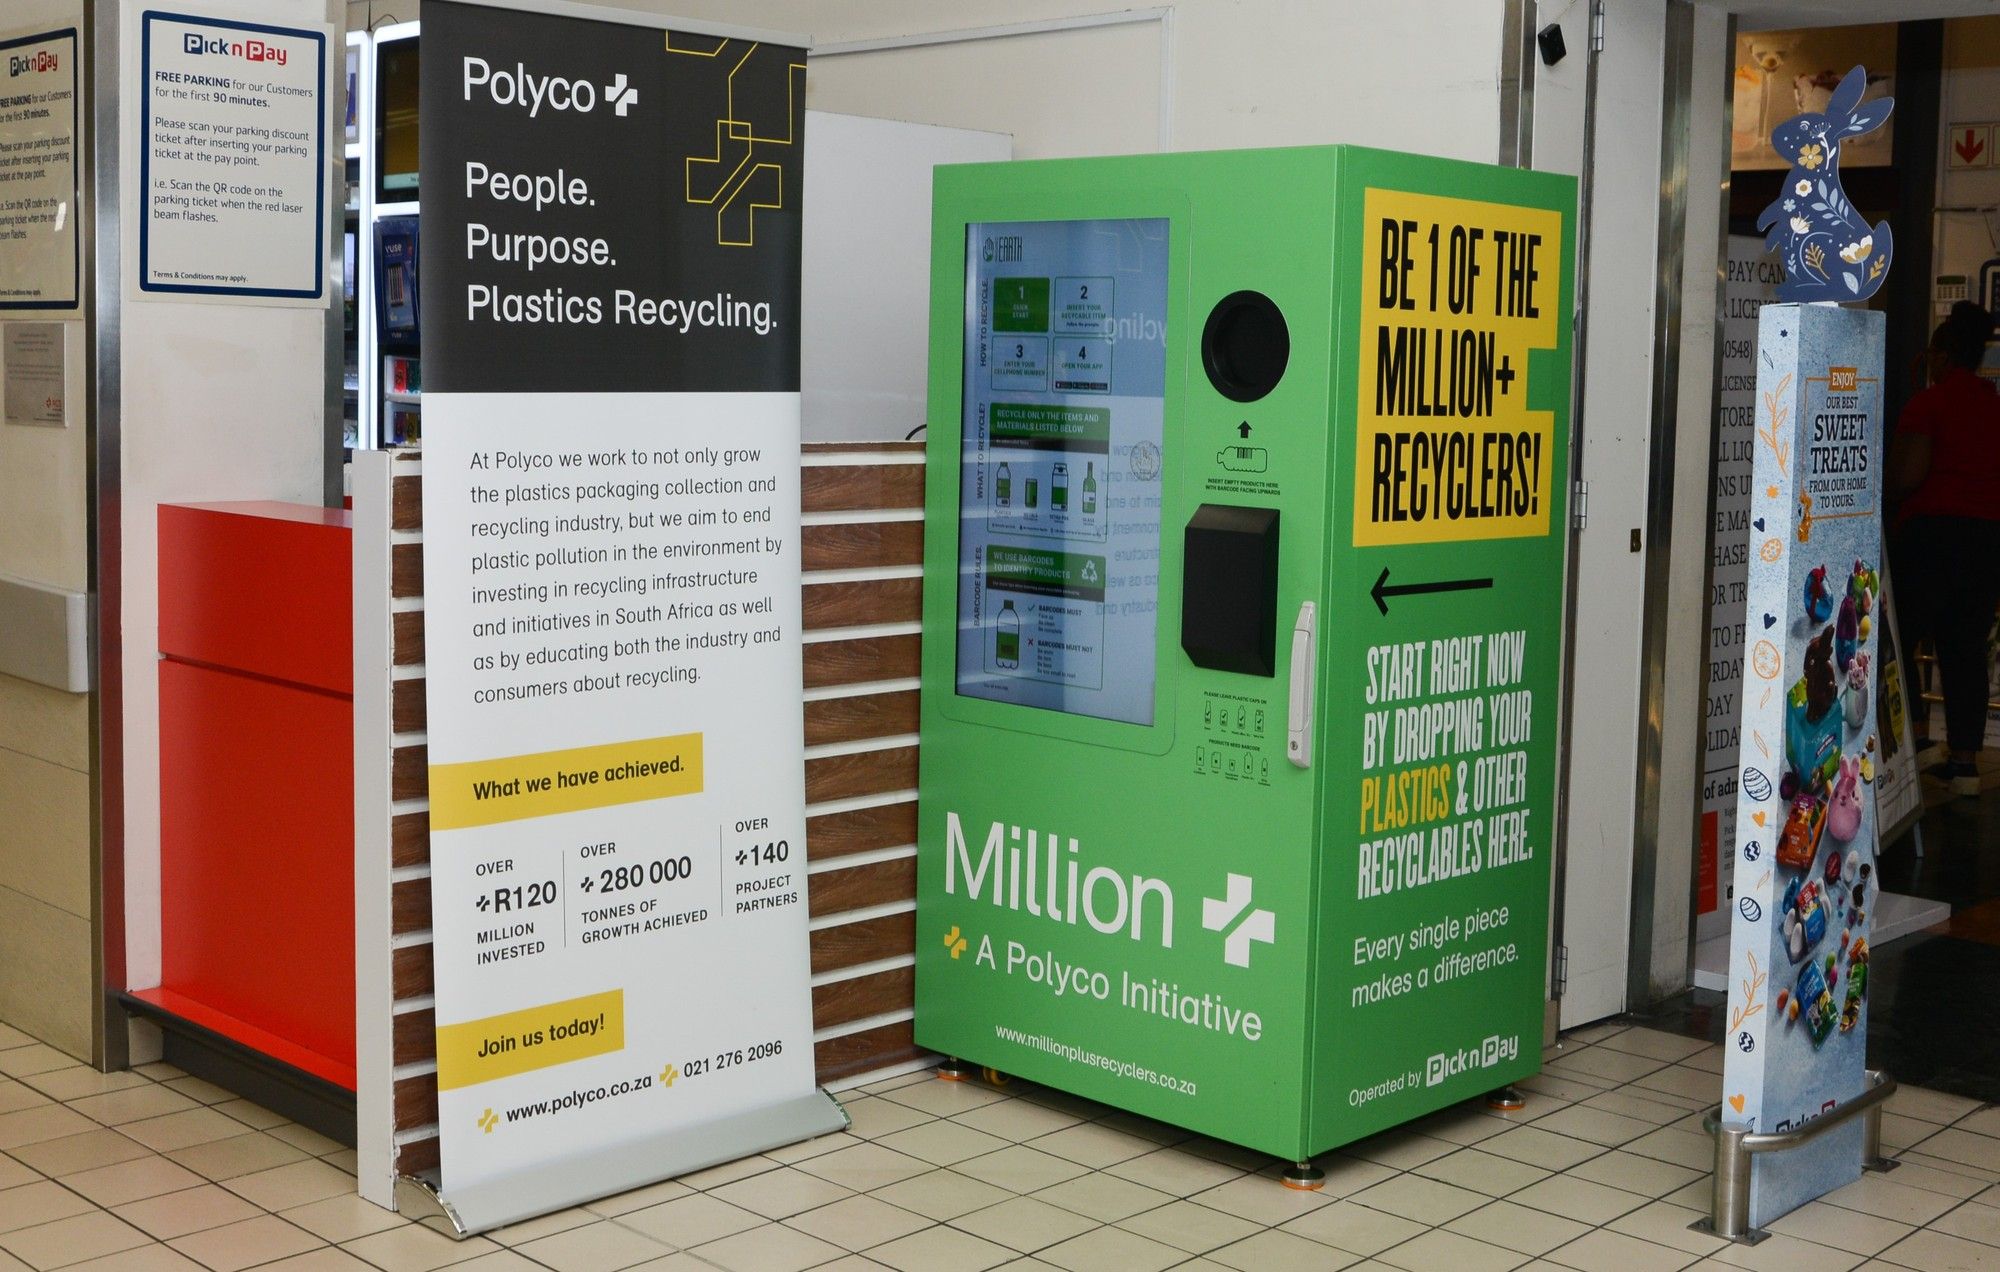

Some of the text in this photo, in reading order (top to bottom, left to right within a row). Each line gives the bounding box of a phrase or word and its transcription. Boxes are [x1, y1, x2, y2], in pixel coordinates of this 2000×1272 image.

[184, 33, 287, 65] Pick n Pay
[155, 71, 313, 98] FREE PARKING for our Customers
[464, 56, 595, 117] Polyco
[154, 180, 283, 197] i.e. Scan the QR code on the
[467, 161, 595, 211] People.
[154, 210, 218, 223] beam flashes.
[467, 223, 616, 271] Purpose.
[154, 271, 173, 279] Terms
[181, 272, 214, 281] Conditions
[230, 275, 248, 283] apply.
[1379, 218, 1541, 319] BE 1 OF THE
[1728, 260, 1754, 281] PAY
[1019, 286, 1024, 299] 1
[1081, 286, 1087, 299] 2
[468, 285, 777, 335] Plastics Recycling.
[981, 328, 987, 341] TO
[1016, 345, 1023, 358] 3
[1079, 346, 1086, 359] 4
[1376, 325, 1515, 418] MILLION+
[1832, 373, 1855, 388] ENJOY
[997, 409, 1026, 418] RECYCLE
[1028, 411, 1045, 419] ONLY
[1826, 397, 1858, 409] OUR BEST
[997, 421, 1084, 433] MATERIALS LISTED BELOW
[1814, 414, 1867, 442] SWEET
[471, 448, 760, 472] At Polyco we work to not only grow
[1811, 446, 1867, 474] TREATS
[1372, 431, 1541, 522] RECYCLERS!
[1809, 478, 1867, 493] FROM OUR HOME
[471, 477, 776, 505] the plastics packaging collection and
[1820, 494, 1855, 508] TO YOURS.
[993, 552, 1054, 565] WE USE BARCODES
[993, 563, 1070, 578] TO IDENTIFY PRODUCTS
[1713, 626, 1730, 647] TO
[1366, 630, 1526, 705] START RIGHT NOW
[474, 666, 700, 703] consumers about recycling.
[1363, 690, 1532, 770] BY DROPPING YOUR
[473, 755, 684, 800] What we have achieved.
[1704, 781, 1715, 800] of
[1360, 751, 1527, 835] PLASTICS & OTHER
[735, 817, 769, 833] OVER
[581, 842, 616, 859] OVER
[1358, 809, 1533, 900] RECYCLABLES HERE.
[476, 859, 514, 877] OVER
[650, 856, 691, 884] 000
[945, 811, 1174, 948] Million
[736, 875, 791, 895] PROJECT
[582, 899, 657, 924] TONNES OF
[736, 892, 798, 914] PARTNERS
[477, 922, 534, 945] MILLION
[582, 909, 708, 944] GROWTH ACHIEVED
[1353, 906, 1509, 966] Every single piece
[477, 941, 545, 965] INVESTED
[975, 934, 1262, 1041] A Polyco Initiative
[1351, 943, 1519, 1009] makes a difference.
[478, 1013, 605, 1058] Join us today!
[996, 1024, 1196, 1097] www.millionplusrecyclers.co.za
[1348, 1033, 1519, 1107] Operated by Pick n Pay
[506, 1040, 783, 1123] www.polyco.co.za 021 276 2096
